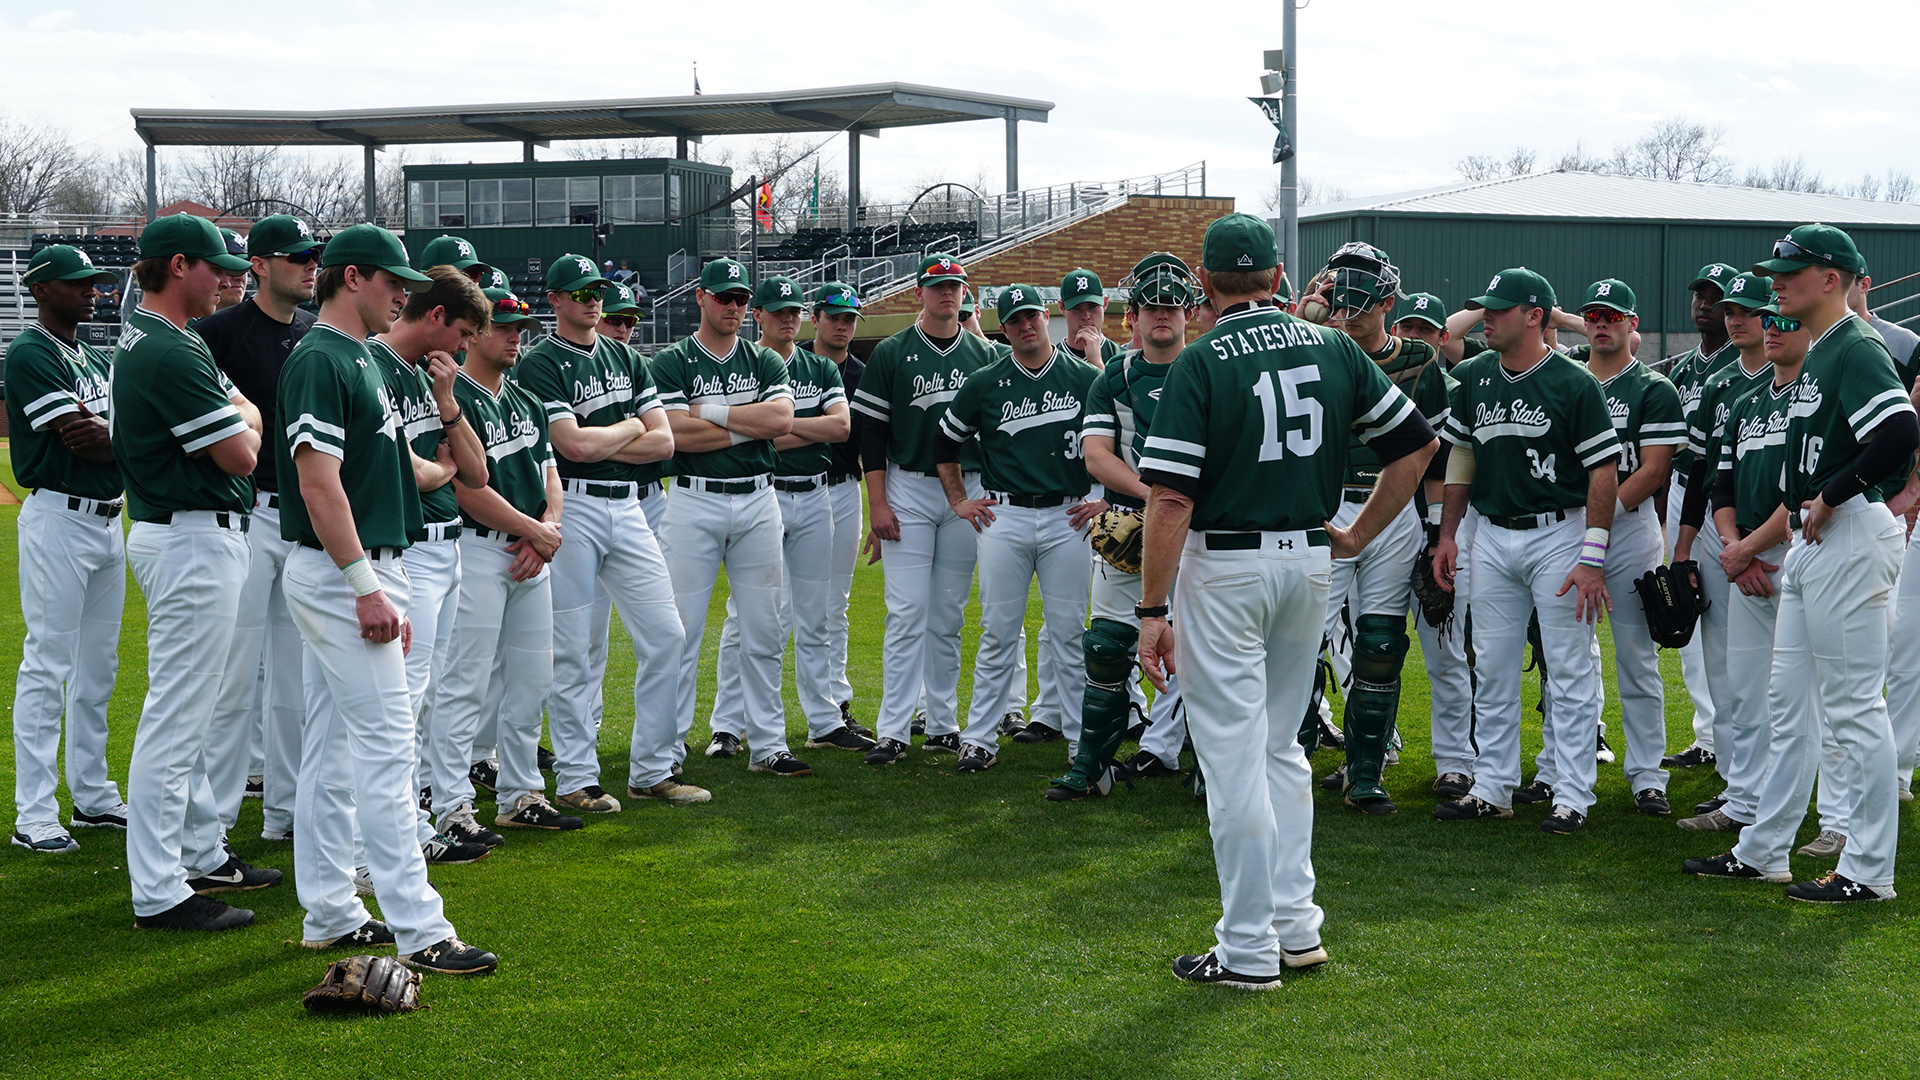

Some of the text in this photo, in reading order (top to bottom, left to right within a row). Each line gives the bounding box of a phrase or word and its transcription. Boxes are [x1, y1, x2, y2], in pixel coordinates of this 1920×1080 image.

[1210, 322, 1325, 361] STATESMEN
[726, 372, 760, 394] State
[789, 379, 821, 399] State
[1001, 390, 1077, 423] Delta State
[1252, 364, 1324, 463] 15
[1510, 399, 1546, 425] State
[485, 411, 536, 447] Delt Sate
[1526, 448, 1557, 483] 34
[1798, 433, 1823, 475] 16
[1660, 576, 1674, 607] EASTON
